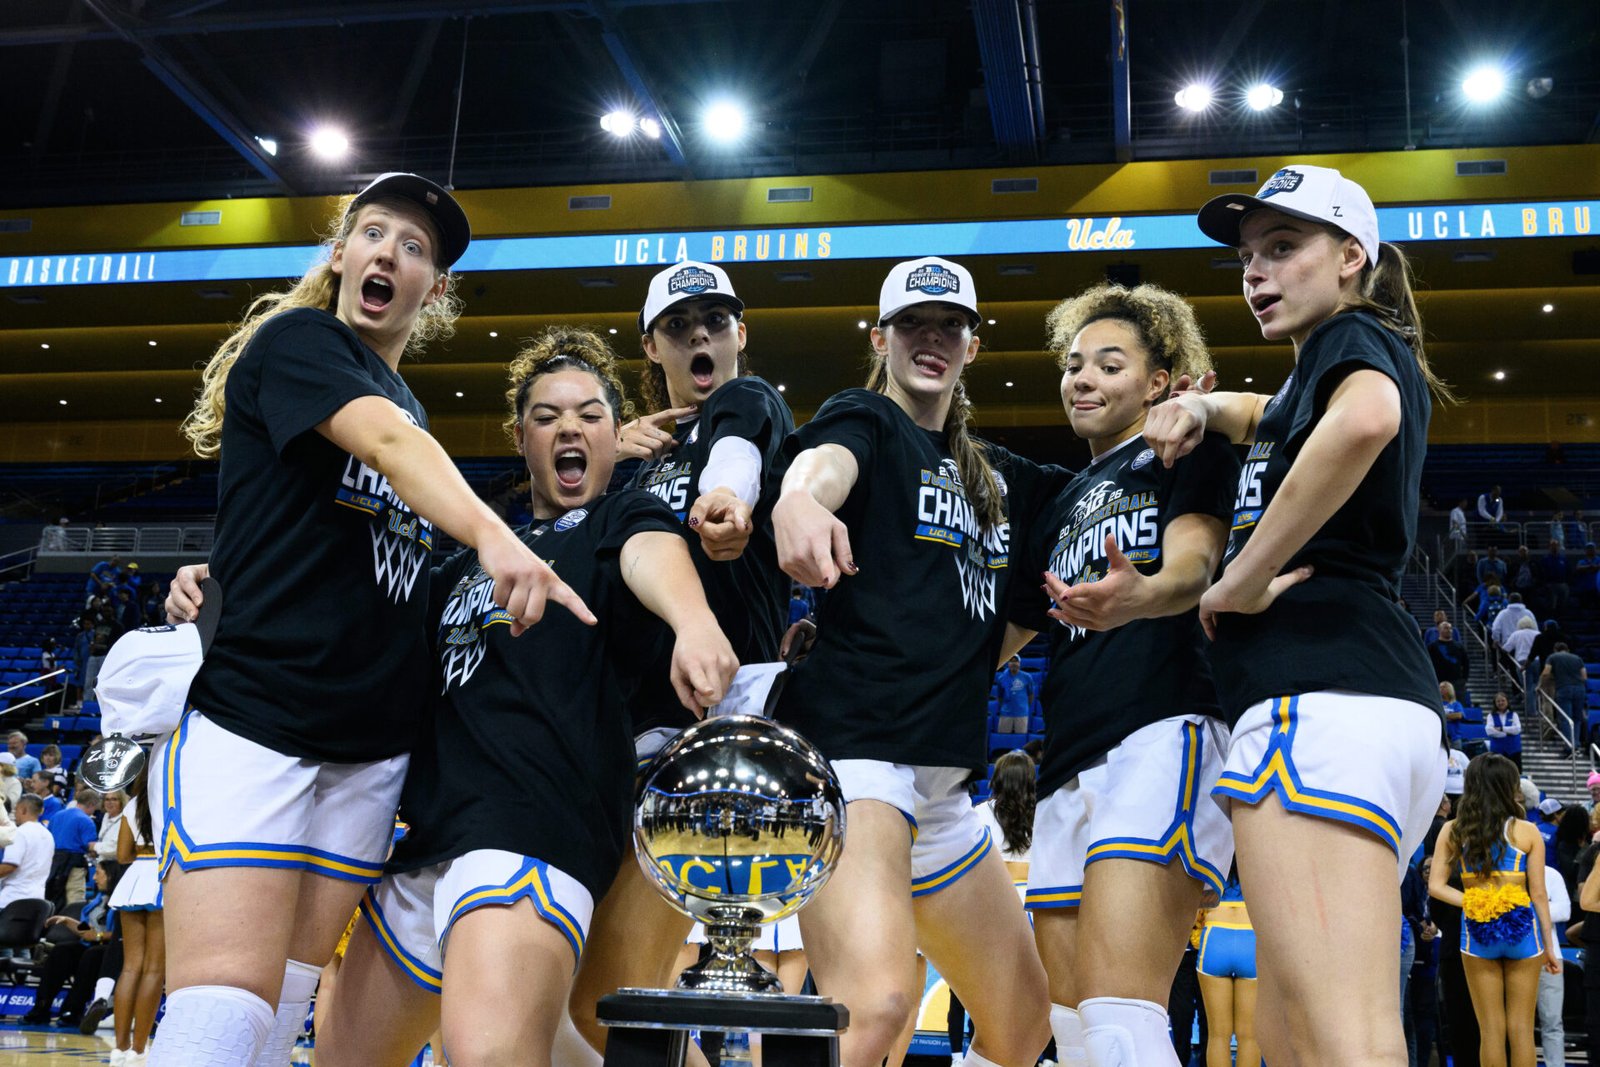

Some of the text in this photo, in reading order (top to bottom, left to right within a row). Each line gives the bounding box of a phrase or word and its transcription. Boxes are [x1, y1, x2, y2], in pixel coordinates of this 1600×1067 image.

[1332, 206, 1344, 218] Z
[1408, 206, 1591, 239] UCLA BRU
[1066, 217, 1134, 250] Ucla
[614, 232, 831, 264] UCLA BRUINS
[8, 255, 155, 285] BASKETBALL
[671, 277, 715, 291] CHAMPIONS
[909, 276, 958, 291] CHAMPIONS
[351, 495, 381, 510] UCLA
[929, 528, 954, 540] UCLA
[87, 748, 129, 763] Zephy
